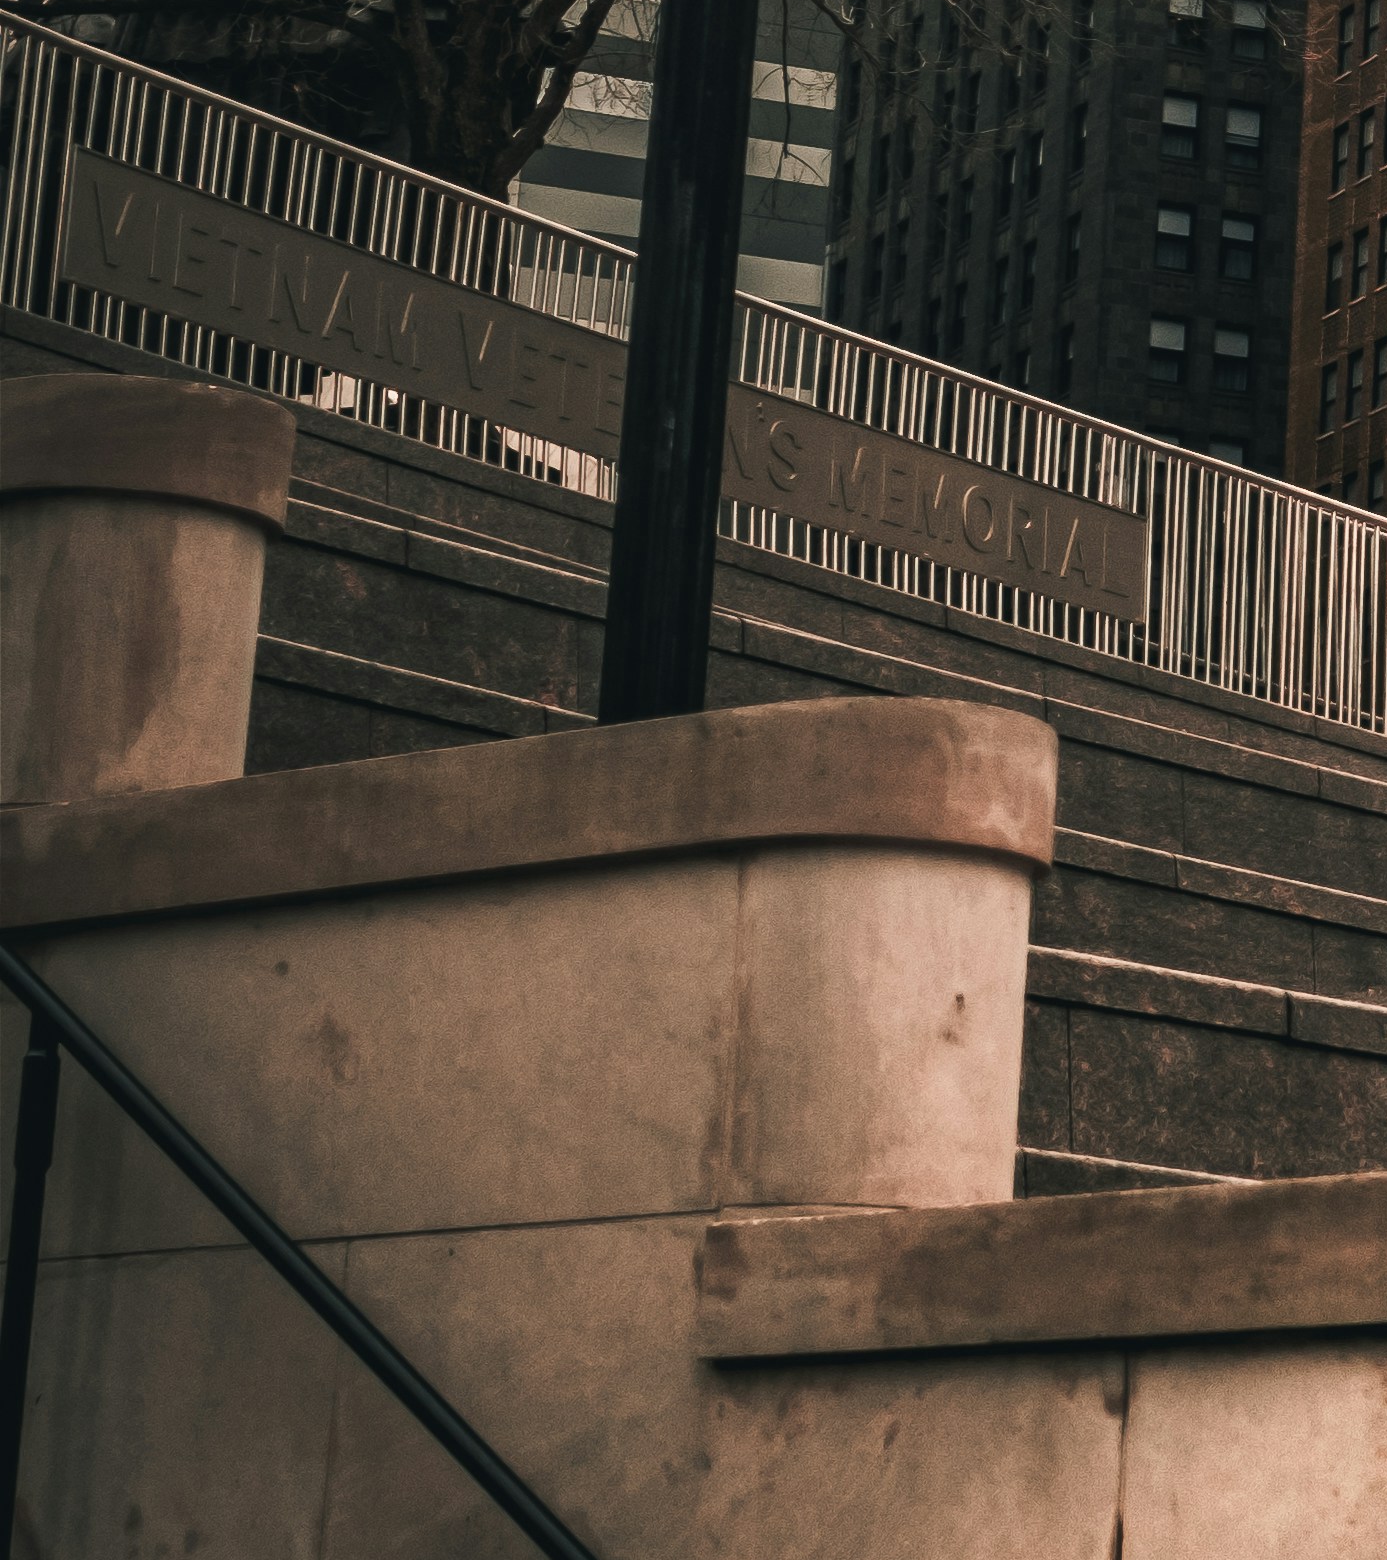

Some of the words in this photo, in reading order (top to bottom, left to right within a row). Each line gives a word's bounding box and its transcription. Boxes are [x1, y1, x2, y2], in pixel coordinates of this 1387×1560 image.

[92, 179, 425, 372] VIETNAM
[457, 310, 803, 493] VETEN'S
[827, 436, 1131, 598] MEMORIAL
